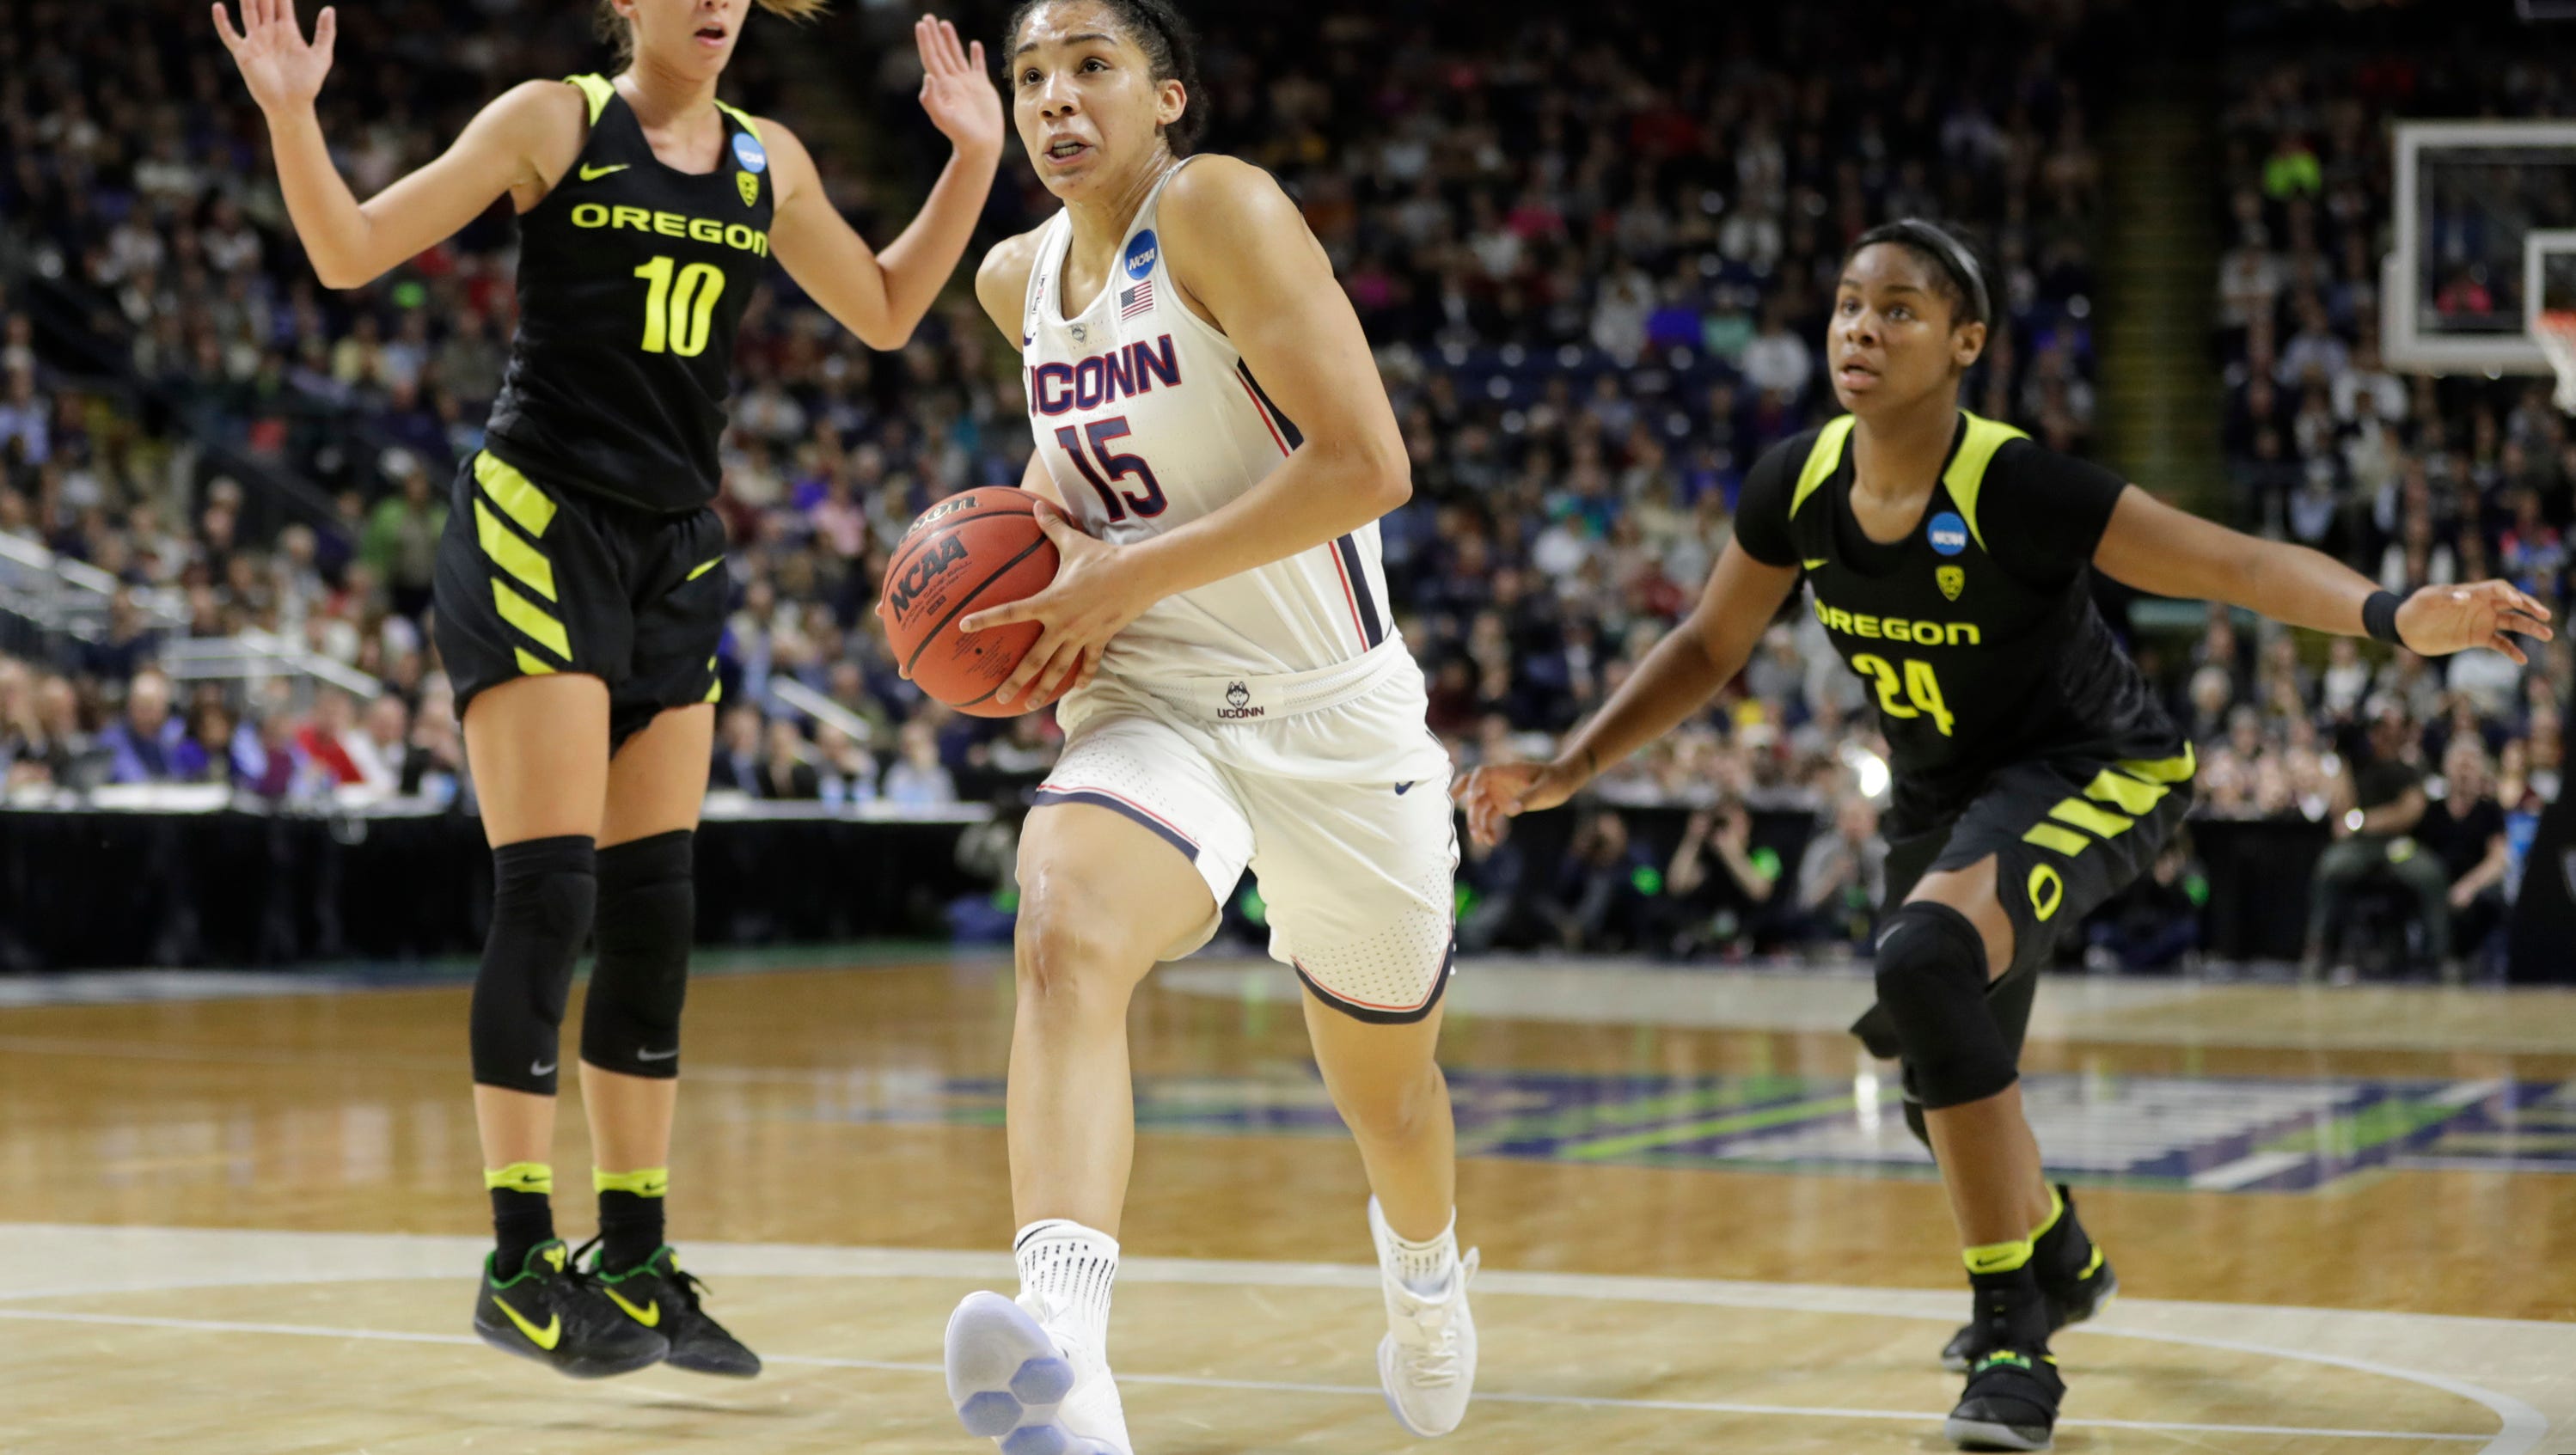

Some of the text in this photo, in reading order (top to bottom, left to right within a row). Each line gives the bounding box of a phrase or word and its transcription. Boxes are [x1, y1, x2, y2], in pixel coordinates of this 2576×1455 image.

[571, 203, 768, 258] OREGON
[1129, 247, 1155, 271] NCAA
[633, 255, 725, 357] 10
[1055, 415, 1168, 523] 15
[890, 535, 969, 624] NCAA
[1814, 597, 1981, 645] OREGON
[1217, 706, 1265, 718] UCONN
[1851, 653, 1955, 737] 24
